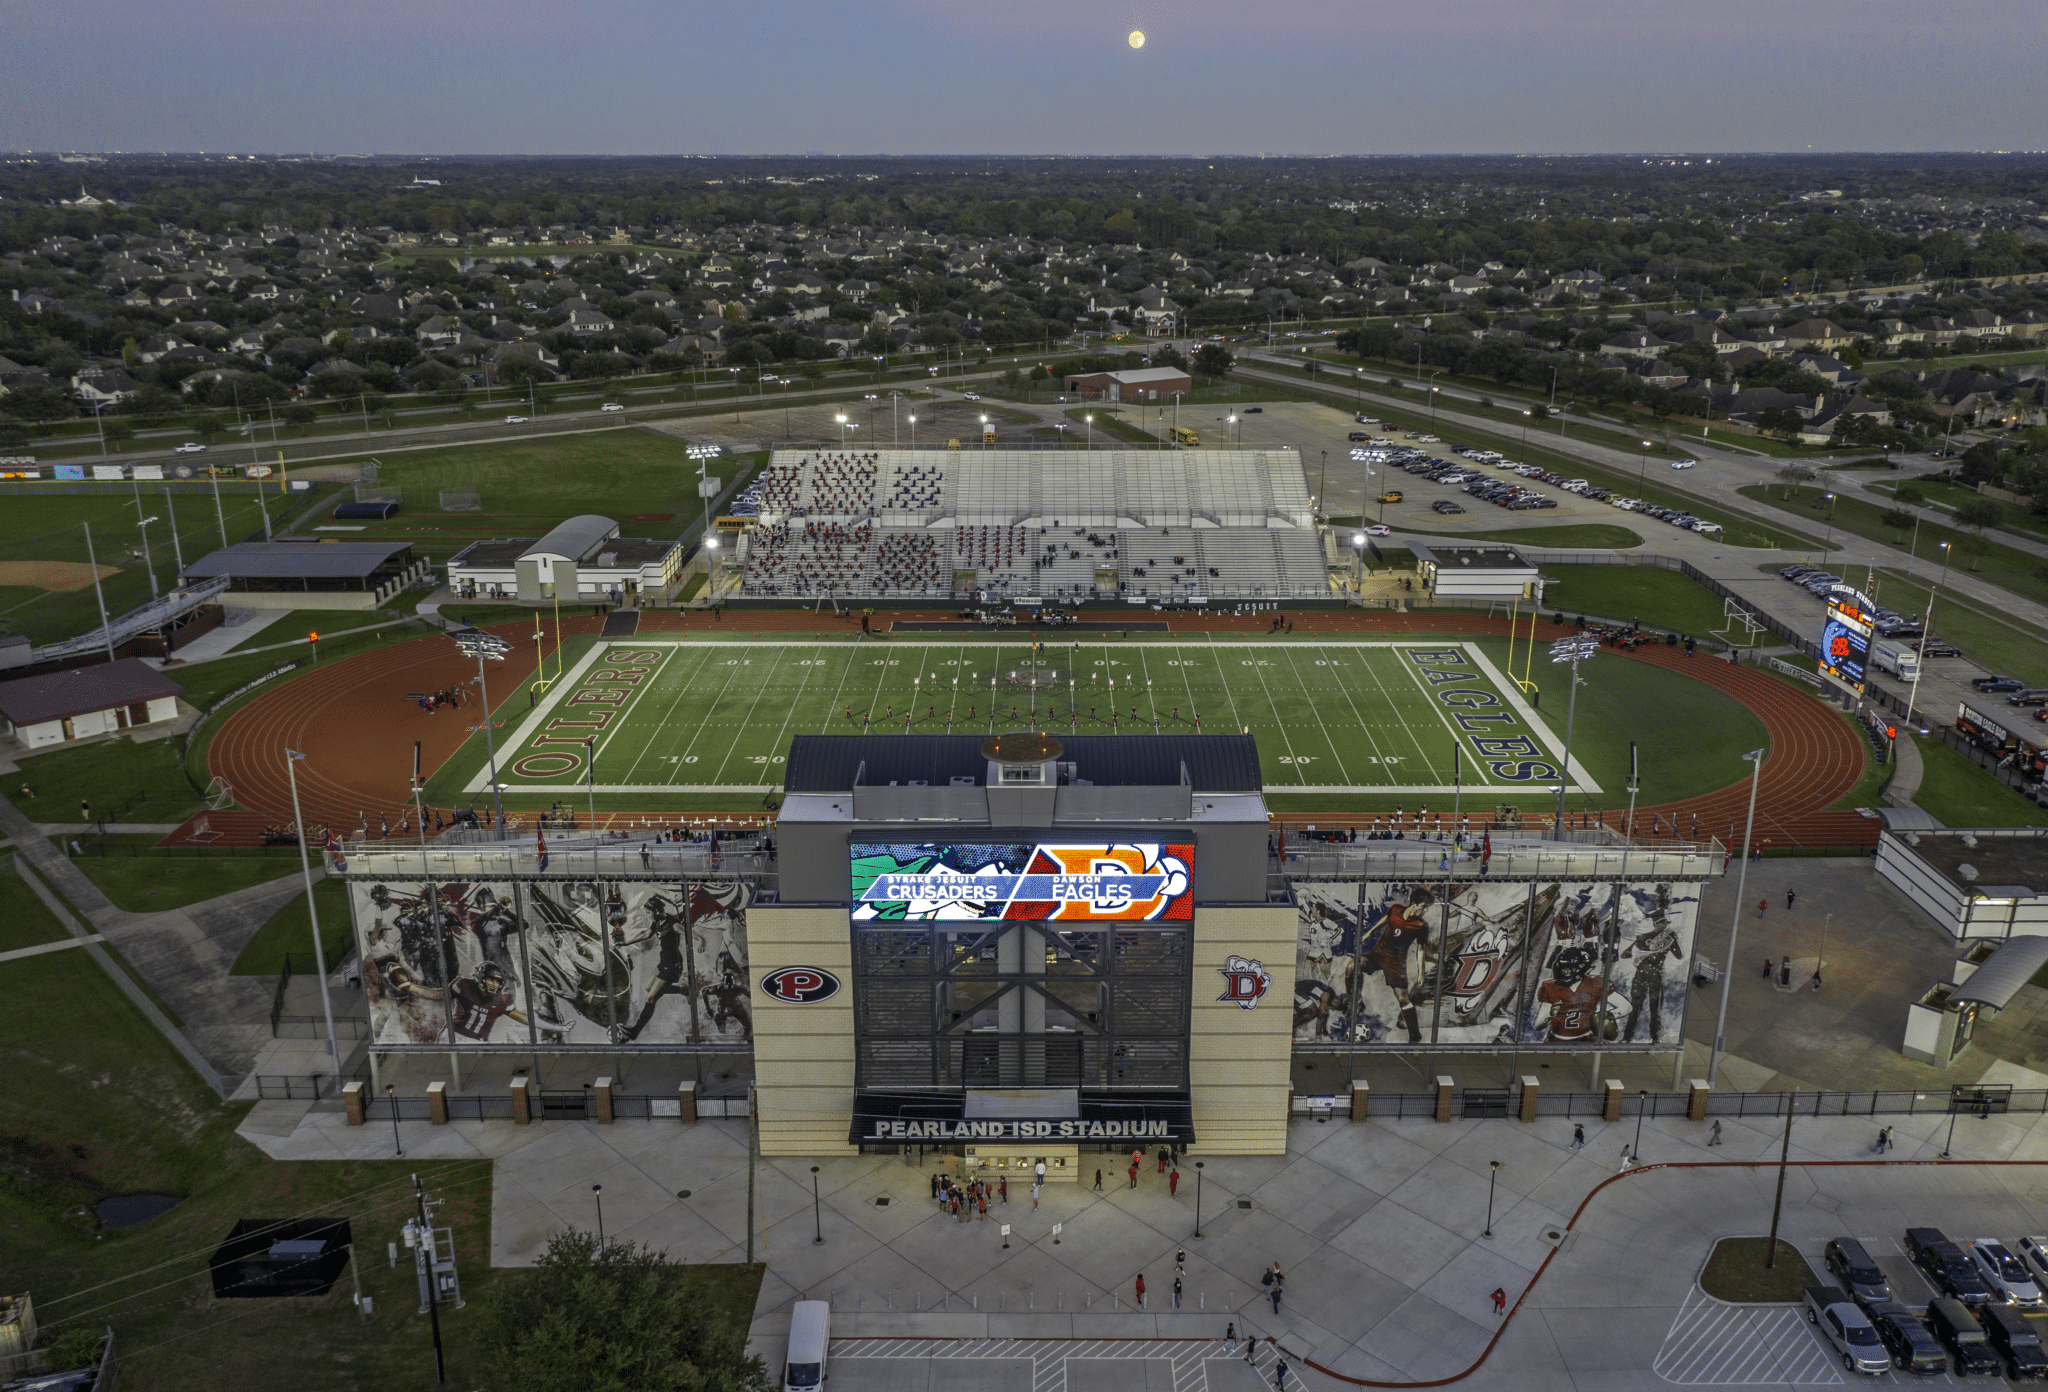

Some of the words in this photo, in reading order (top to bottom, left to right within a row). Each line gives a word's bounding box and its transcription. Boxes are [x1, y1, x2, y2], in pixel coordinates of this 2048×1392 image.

[1237, 603, 1278, 611] JESUIT
[512, 650, 662, 778] OILERS
[1405, 649, 1563, 781] EAGLES
[668, 755, 699, 764] 10
[752, 755, 786, 764] 20
[1278, 755, 1312, 764] 20
[1367, 756, 1399, 764] 10
[887, 875, 931, 884] STRAKE
[935, 875, 978, 884] JESUIT
[1052, 875, 1101, 884] DAWSON
[887, 884, 998, 900] CRUSADERS
[1052, 884, 1132, 900] EAGLES
[773, 969, 824, 1001] P
[1218, 970, 1267, 1002] D
[465, 1009, 487, 1034] 11
[1564, 1009, 1581, 1029] 2
[875, 1120, 1004, 1136] PEARLAND
[1012, 1120, 1052, 1136] ISD
[1059, 1120, 1168, 1136] STADIUM
